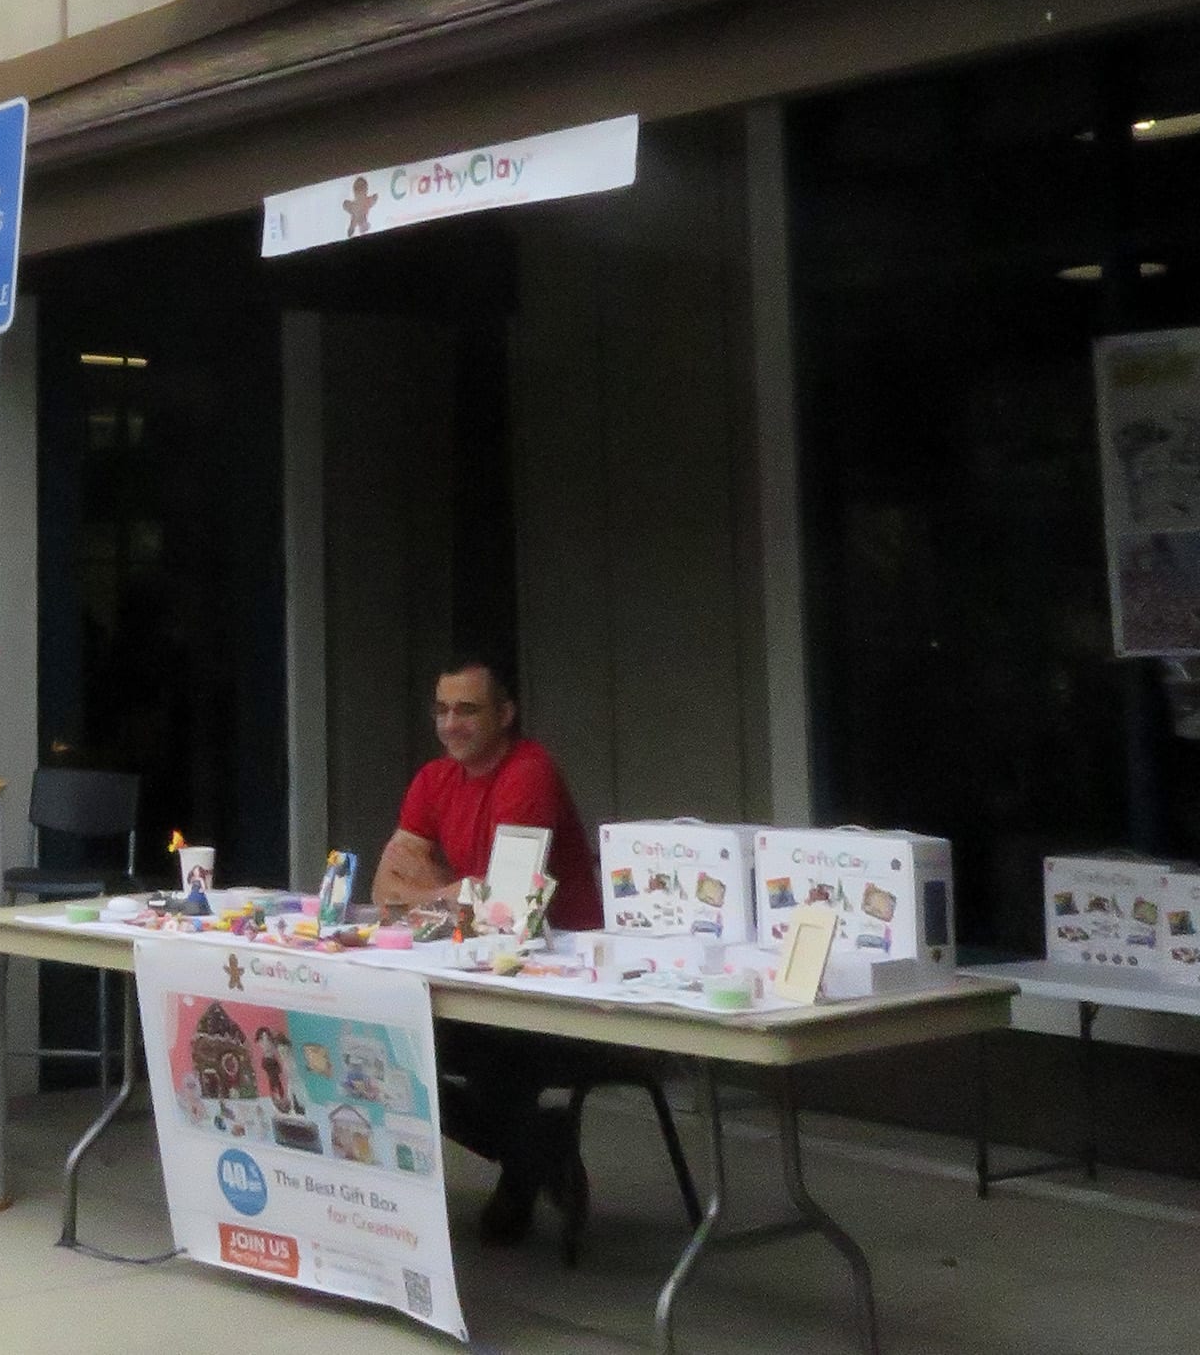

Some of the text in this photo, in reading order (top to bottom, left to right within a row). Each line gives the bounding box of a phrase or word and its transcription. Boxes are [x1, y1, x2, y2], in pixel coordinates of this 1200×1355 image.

[391, 154, 523, 200] CraftyClay
[250, 957, 329, 988] CraftyClay
[273, 1167, 301, 1190] The
[305, 1174, 336, 1197] Best
[340, 1183, 367, 1207] Gift
[369, 1191, 398, 1213] Box
[230, 1230, 291, 1259] JOIN US
[326, 1204, 418, 1250] for Creativity
